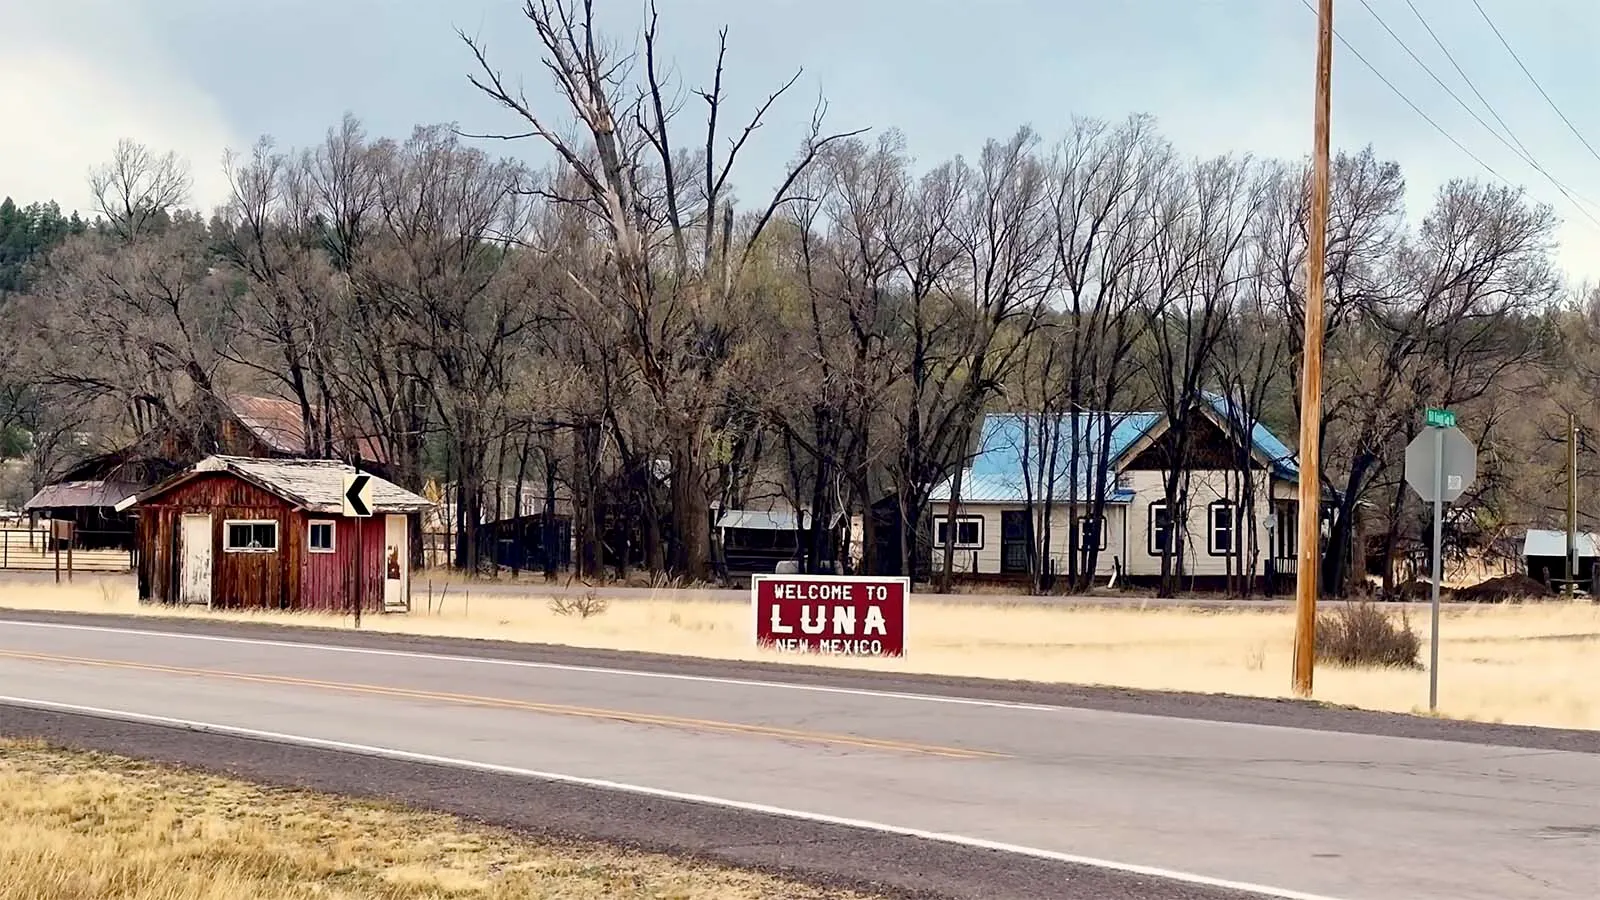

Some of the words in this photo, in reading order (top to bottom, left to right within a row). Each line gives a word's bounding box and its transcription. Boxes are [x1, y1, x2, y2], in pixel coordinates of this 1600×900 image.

[774, 584, 853, 600] WELCOME
[866, 586, 887, 600] TO
[770, 604, 888, 635] LUNA
[775, 638, 808, 653] NEW
[820, 639, 881, 654] MEXICO
